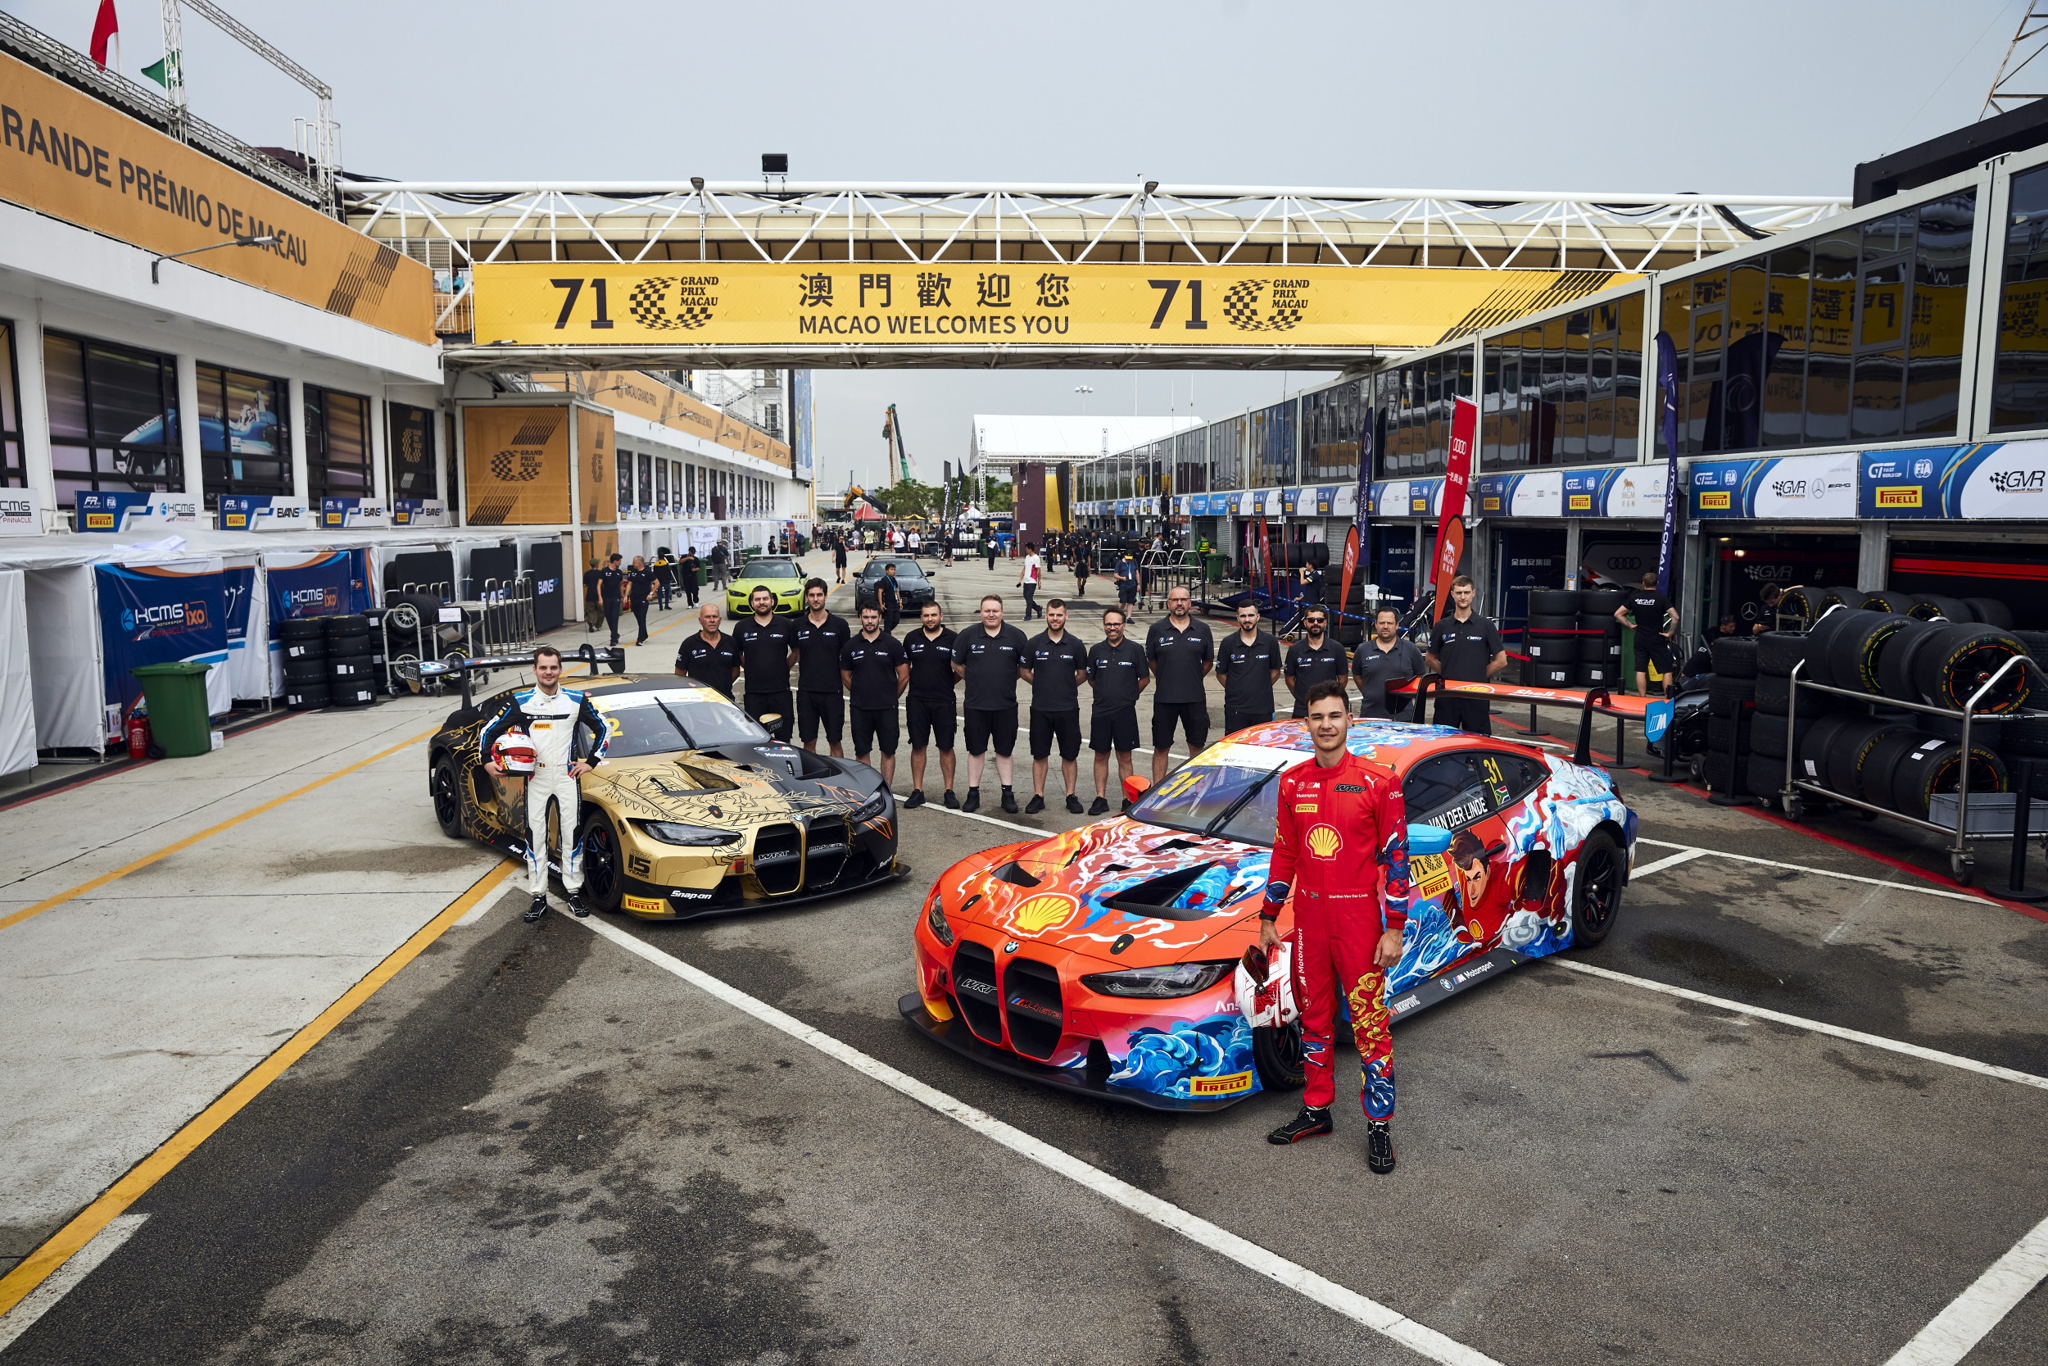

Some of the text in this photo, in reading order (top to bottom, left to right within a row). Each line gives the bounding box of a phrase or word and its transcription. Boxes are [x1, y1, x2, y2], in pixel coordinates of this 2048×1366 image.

[0, 104, 111, 187] RANDE
[119, 157, 212, 228] PRÉMIO
[217, 201, 243, 240] DE
[680, 276, 719, 286] GRAND
[1273, 279, 1310, 289] GRAND
[680, 286, 706, 296] PRIX
[798, 272, 1070, 308] 澳門歡迎您
[1272, 289, 1297, 298] PRIX
[549, 278, 614, 329] 71
[680, 296, 719, 306] MACAU
[1147, 279, 1208, 329] 71
[1271, 299, 1309, 309] MACAU
[799, 315, 1069, 334] MACAO WELCOMES YOU
[2006, 470, 2046, 488] GVR
[1782, 480, 1806, 494] GVR
[1571, 497, 1588, 507] PIRELLI
[1702, 495, 1728, 506] PIRELLI
[1880, 490, 1917, 504] PIRELLI
[0, 501, 31, 511] CMG
[89, 515, 112, 525] PIRELLI
[228, 515, 245, 525] PIRELLI
[1659, 510, 1672, 574] GLOBAL
[1759, 565, 1793, 578] GVR
[185, 602, 205, 626] ixo
[1483, 757, 1503, 784] 31
[1157, 771, 1204, 798] 31
[1428, 797, 1488, 829] VAN DER LINDE
[628, 854, 651, 874] 15
[1411, 858, 1428, 878] 71
[629, 869, 649, 879] YEARS
[1423, 877, 1449, 896] PIRELLI
[670, 890, 713, 900] Snap-on
[628, 899, 660, 911] PIRELLI
[1463, 961, 1495, 979] Motorsport
[961, 978, 998, 994] WRT
[1195, 1075, 1248, 1092] PIRELLI
